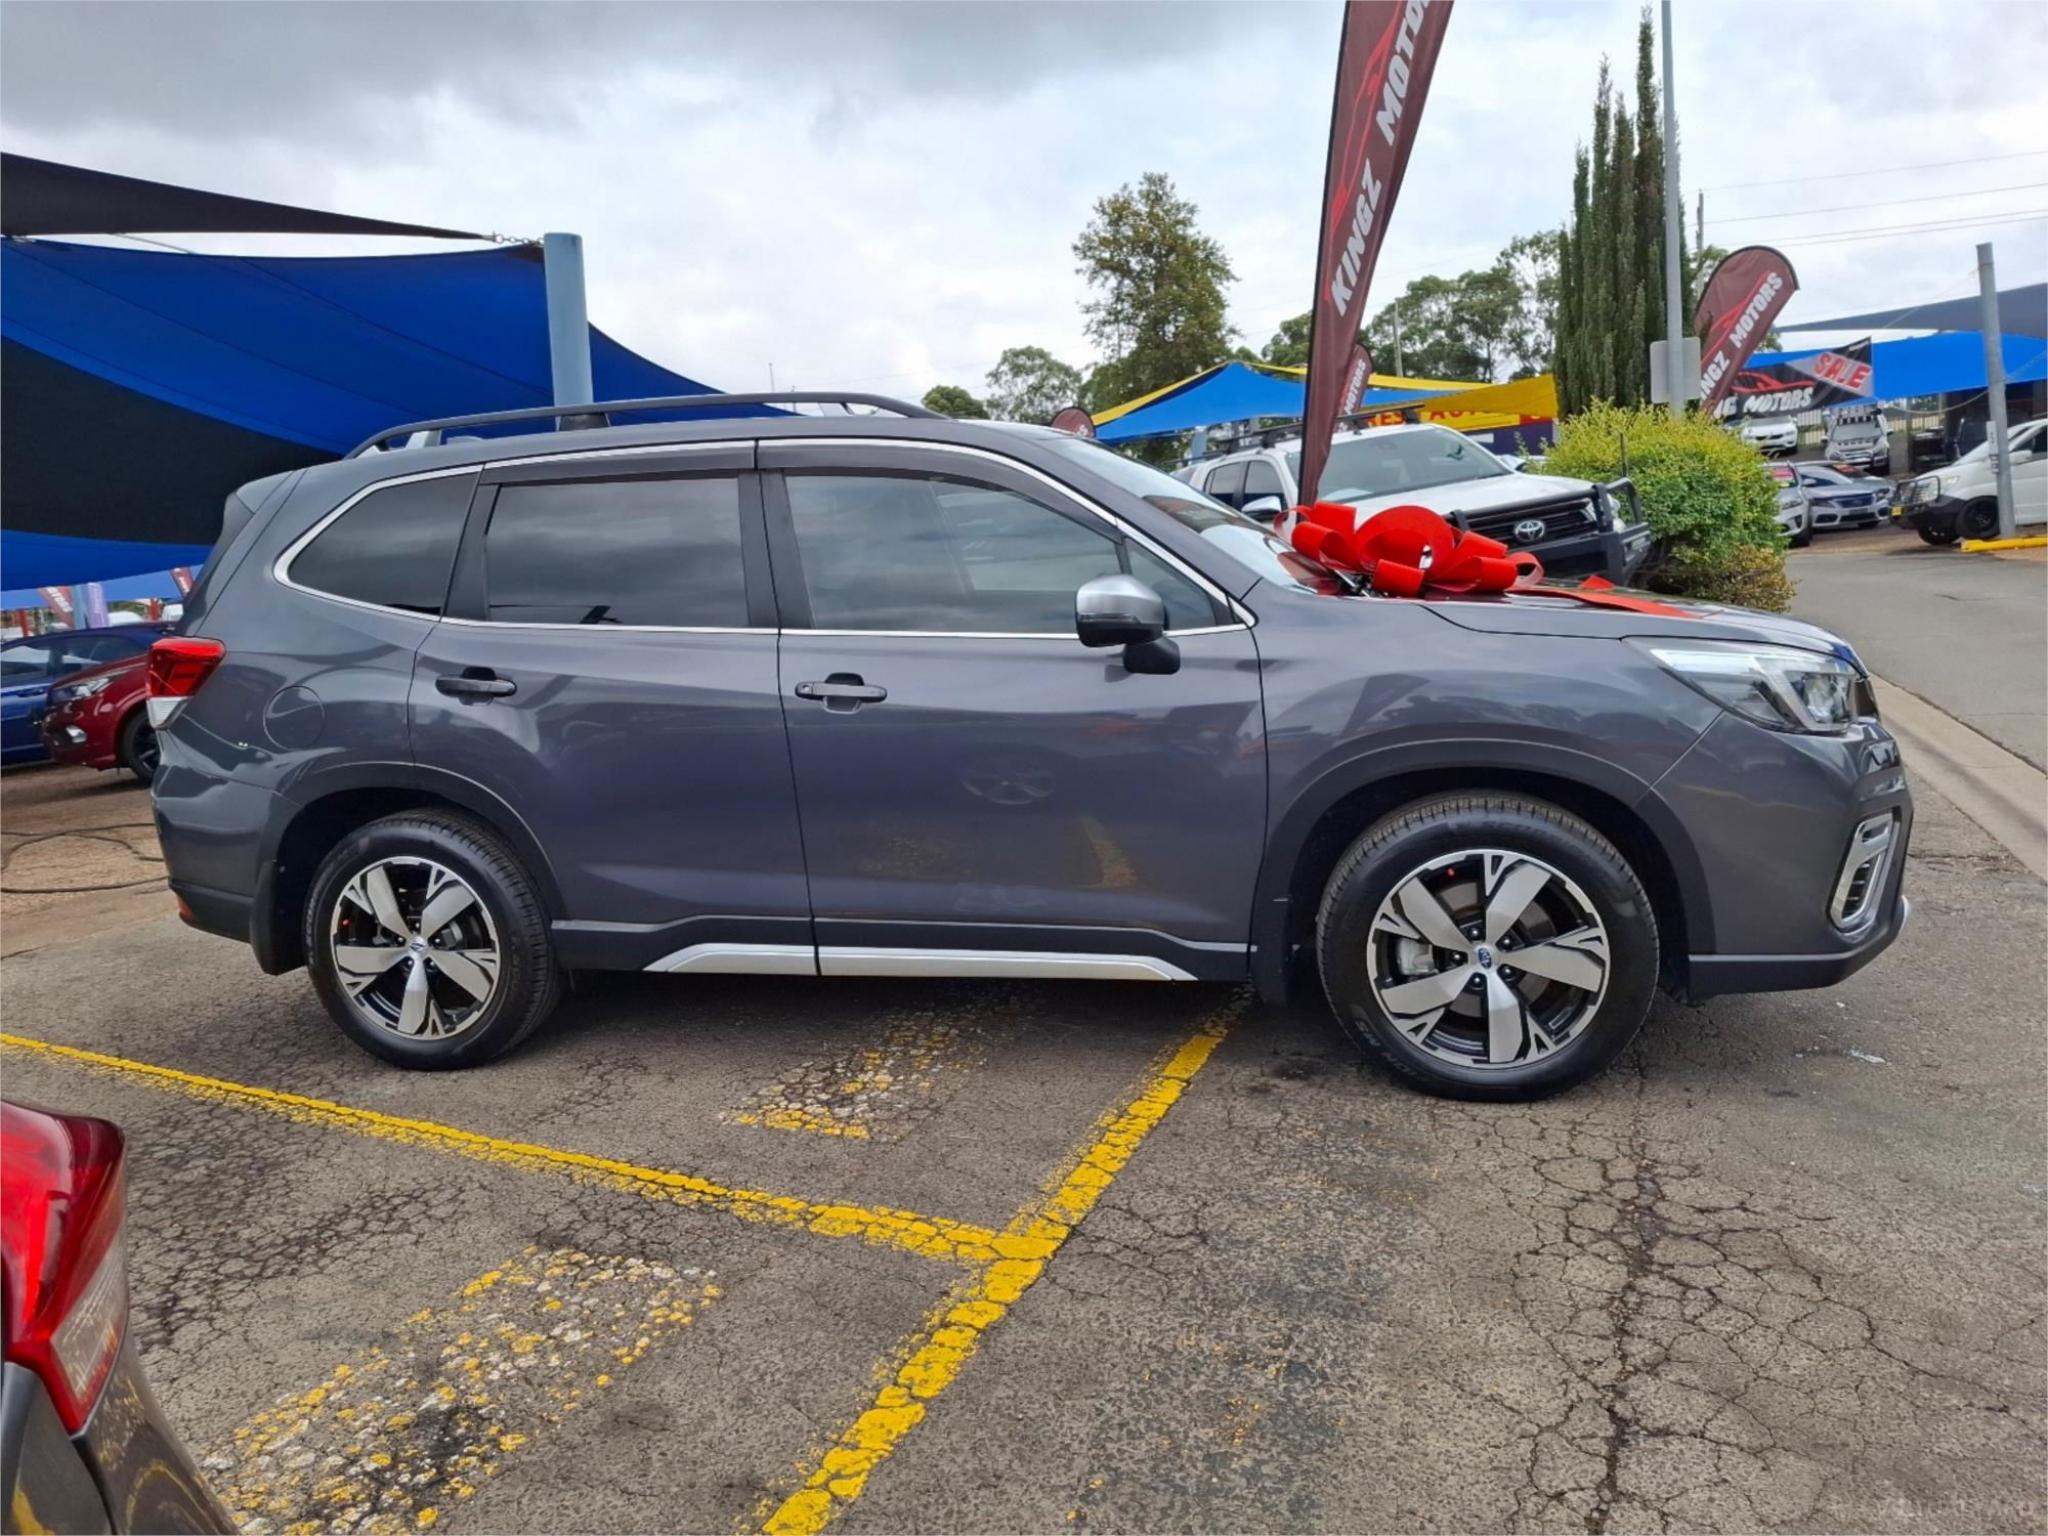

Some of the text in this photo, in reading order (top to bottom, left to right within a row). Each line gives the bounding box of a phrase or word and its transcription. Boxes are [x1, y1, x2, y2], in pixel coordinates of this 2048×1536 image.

[1331, 0, 1430, 317] KINGZ MOTO
[1729, 272, 1783, 348] MOTORS
[1813, 352, 1872, 389] SALE
[1743, 386, 1815, 413] MOTORS
